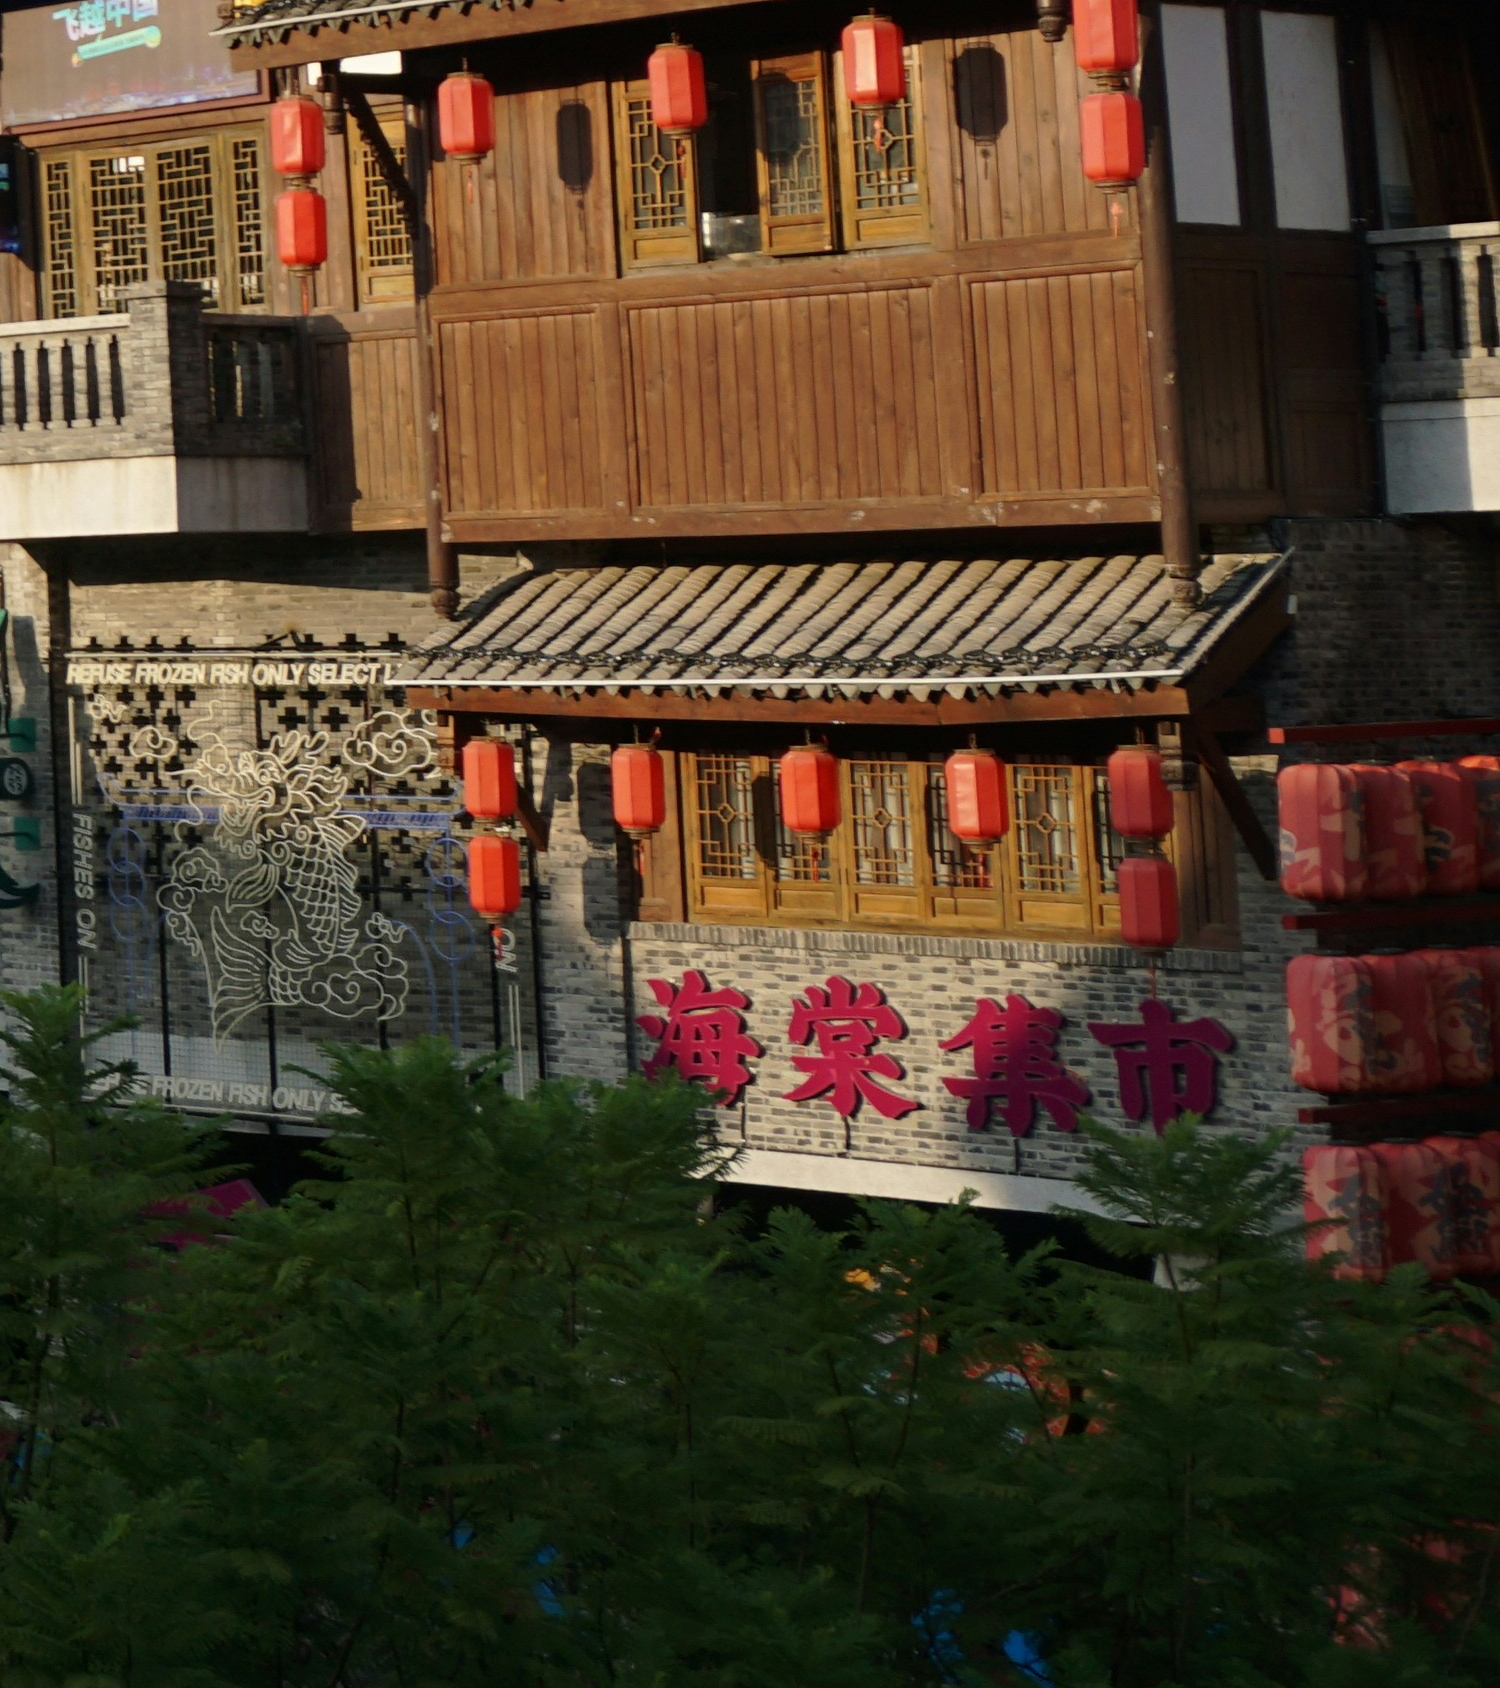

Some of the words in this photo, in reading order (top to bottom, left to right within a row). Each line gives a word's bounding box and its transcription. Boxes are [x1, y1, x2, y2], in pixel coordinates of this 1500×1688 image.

[66, 663, 132, 685] REFUSE
[135, 663, 205, 685] FROZEN
[209, 663, 249, 685] FISH
[252, 663, 305, 685] ONLY
[308, 663, 381, 685] SELECT
[72, 813, 95, 900] FISHES
[75, 908, 98, 950] ON
[636, 968, 1237, 1139] 海棠集市
[152, 1076, 223, 1102] FROZEN
[228, 1081, 268, 1106] FISH
[273, 1086, 327, 1112] ONLY
